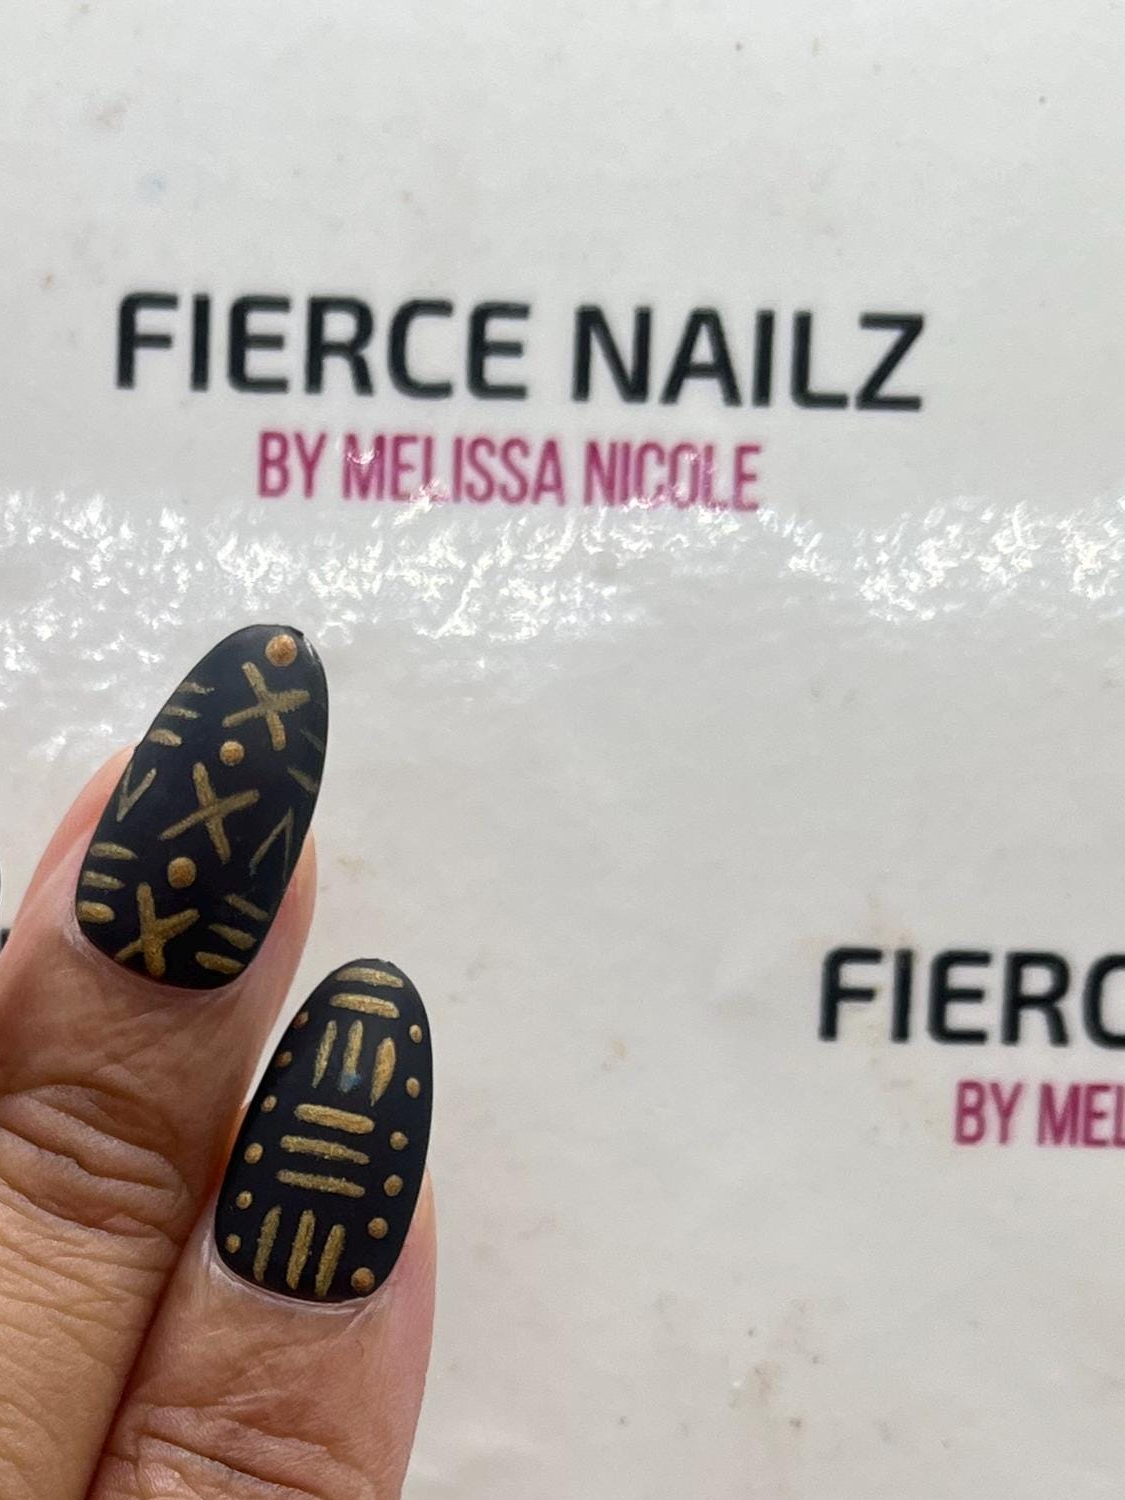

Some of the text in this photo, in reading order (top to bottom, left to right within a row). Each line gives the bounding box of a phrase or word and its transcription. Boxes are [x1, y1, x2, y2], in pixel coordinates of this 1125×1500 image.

[118, 293, 925, 412] FIERCE NAILZ
[259, 432, 762, 511] BY MELISSA NICOLE
[955, 1080, 1025, 1147] BY
